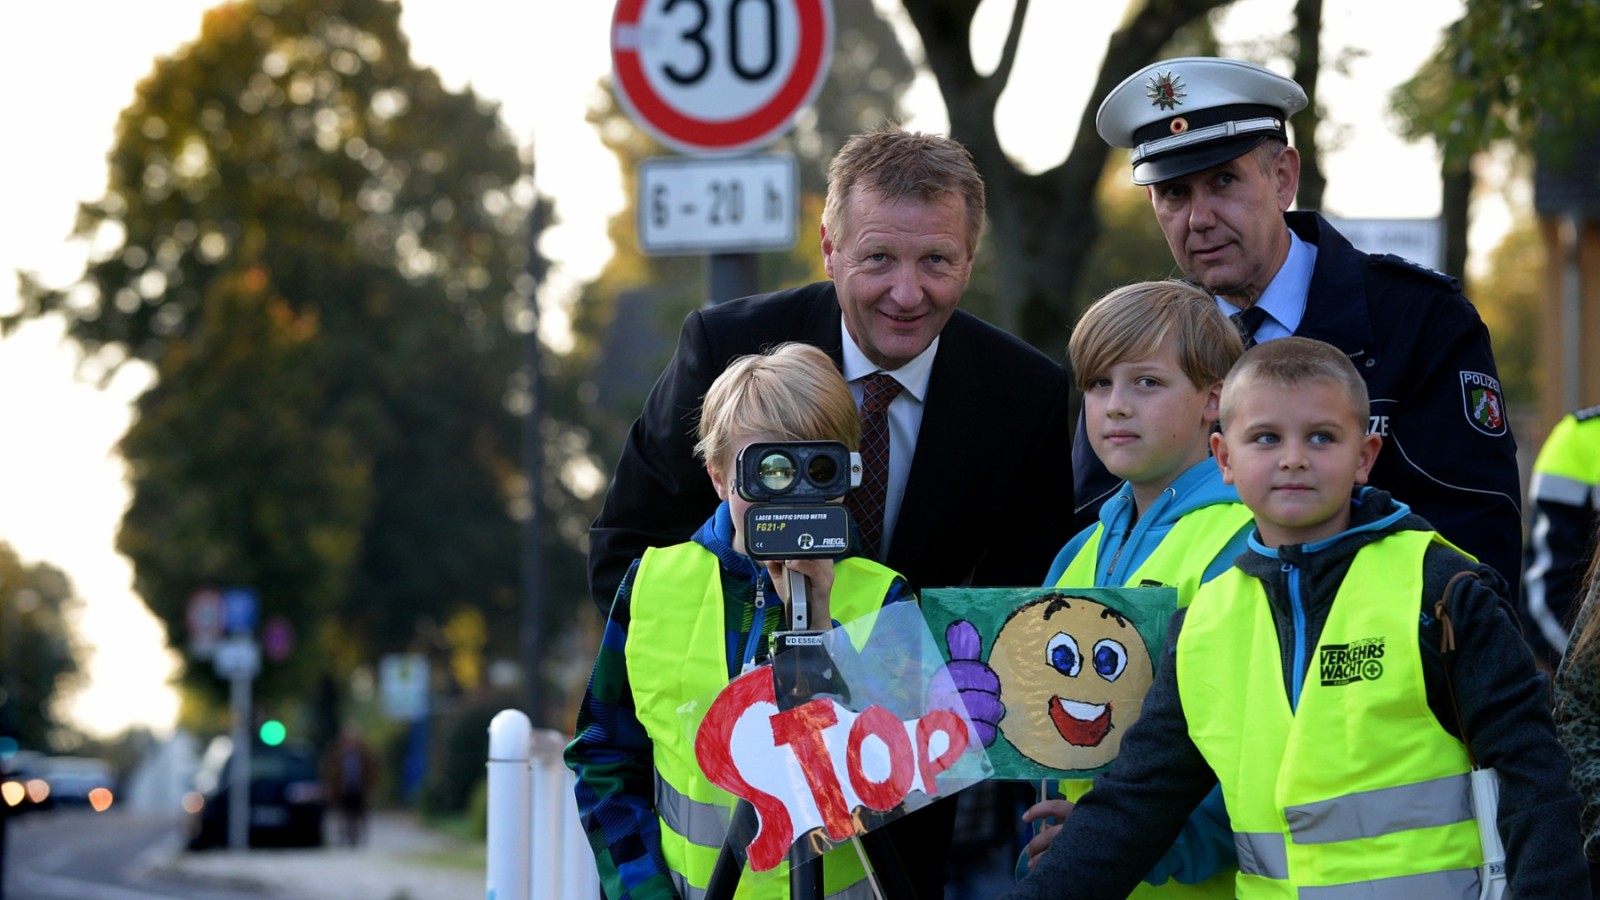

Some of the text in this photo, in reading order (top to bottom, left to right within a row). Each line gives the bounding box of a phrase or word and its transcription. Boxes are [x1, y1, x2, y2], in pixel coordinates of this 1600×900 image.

[661, 0, 779, 85] 30
[756, 522, 786, 532] FG21-P
[822, 537, 846, 545] RIEGL
[1320, 643, 1385, 666] VERKEHRS
[1320, 660, 1363, 680] WACHT
[694, 664, 969, 873] STOP
